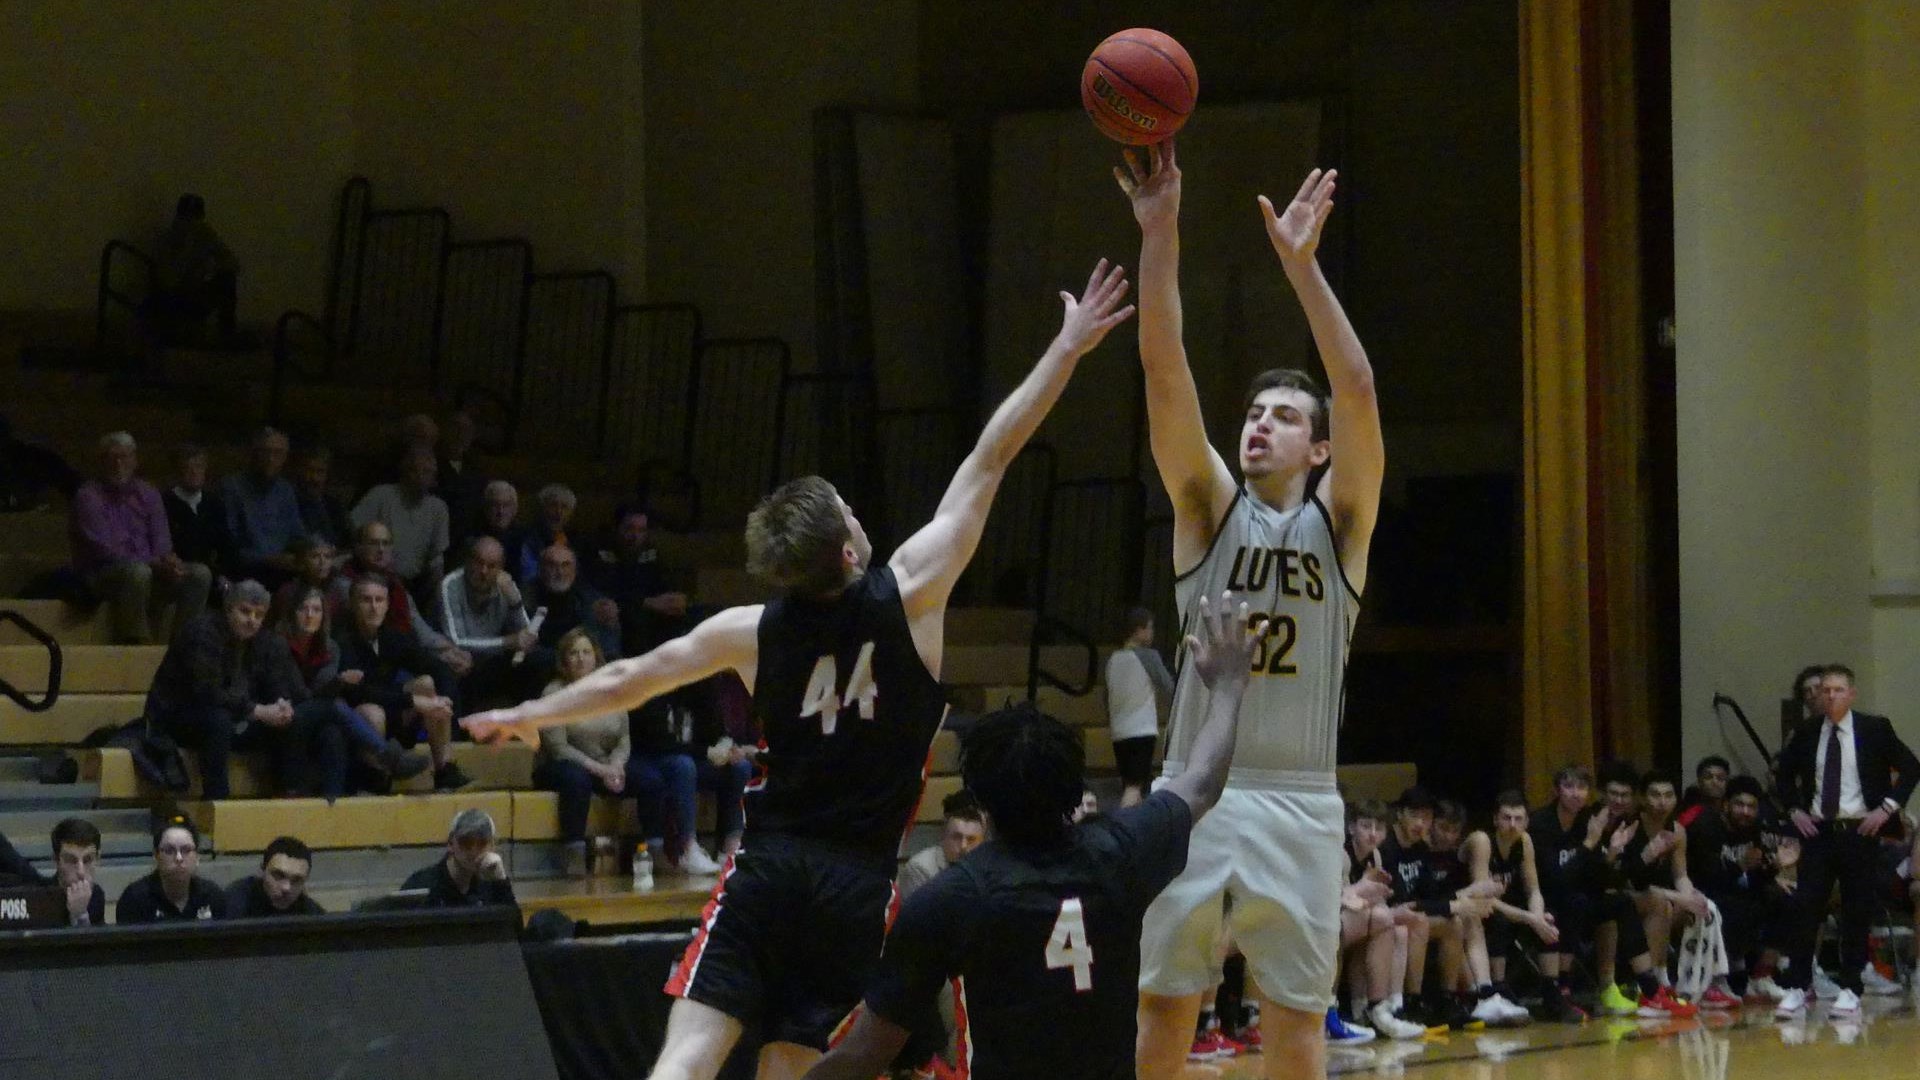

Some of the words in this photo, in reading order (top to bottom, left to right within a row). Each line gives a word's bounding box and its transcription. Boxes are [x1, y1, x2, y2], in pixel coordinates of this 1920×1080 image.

[1093, 71, 1158, 131] Wilson
[1227, 545, 1324, 602] LUTES
[799, 641, 879, 734] 44
[1, 898, 30, 920] POSS.
[1045, 897, 1093, 991] 4
